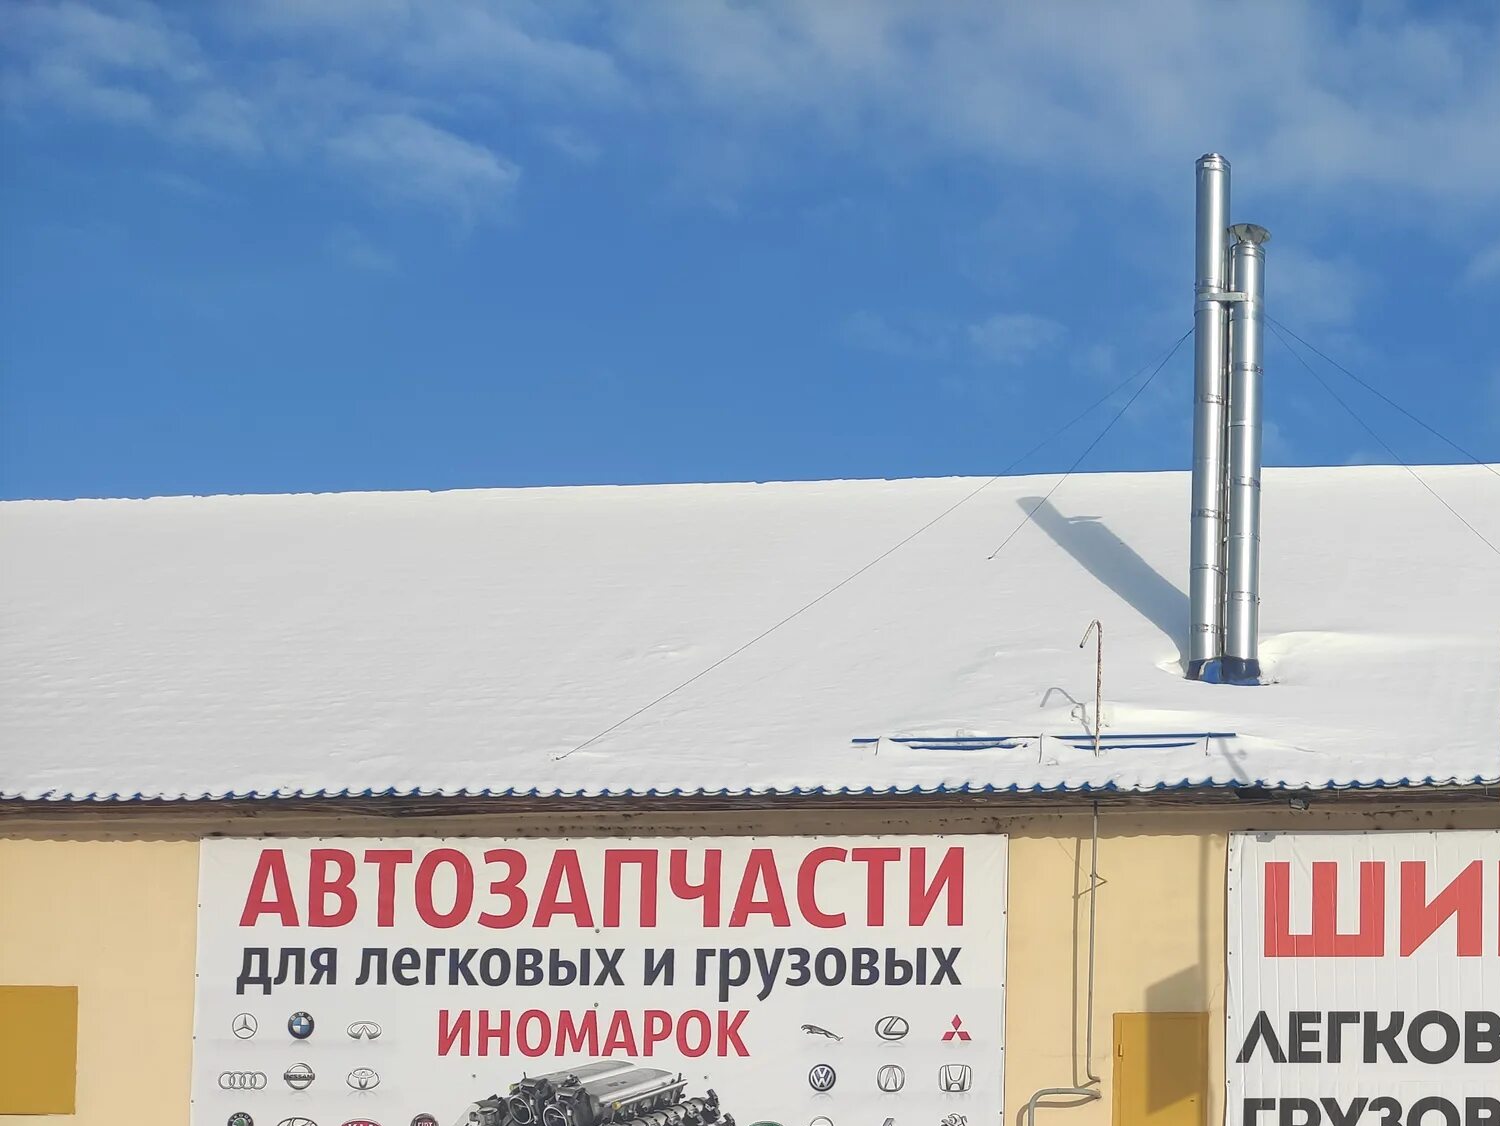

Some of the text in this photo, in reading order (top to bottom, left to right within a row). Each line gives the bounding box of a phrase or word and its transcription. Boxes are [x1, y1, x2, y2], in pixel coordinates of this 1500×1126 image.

[240, 847, 965, 928] АВТОЗАПЧАСТИ
[236, 945, 962, 1002] для легковых и грузовых
[438, 1009, 750, 1057] ИНОМАРОК
